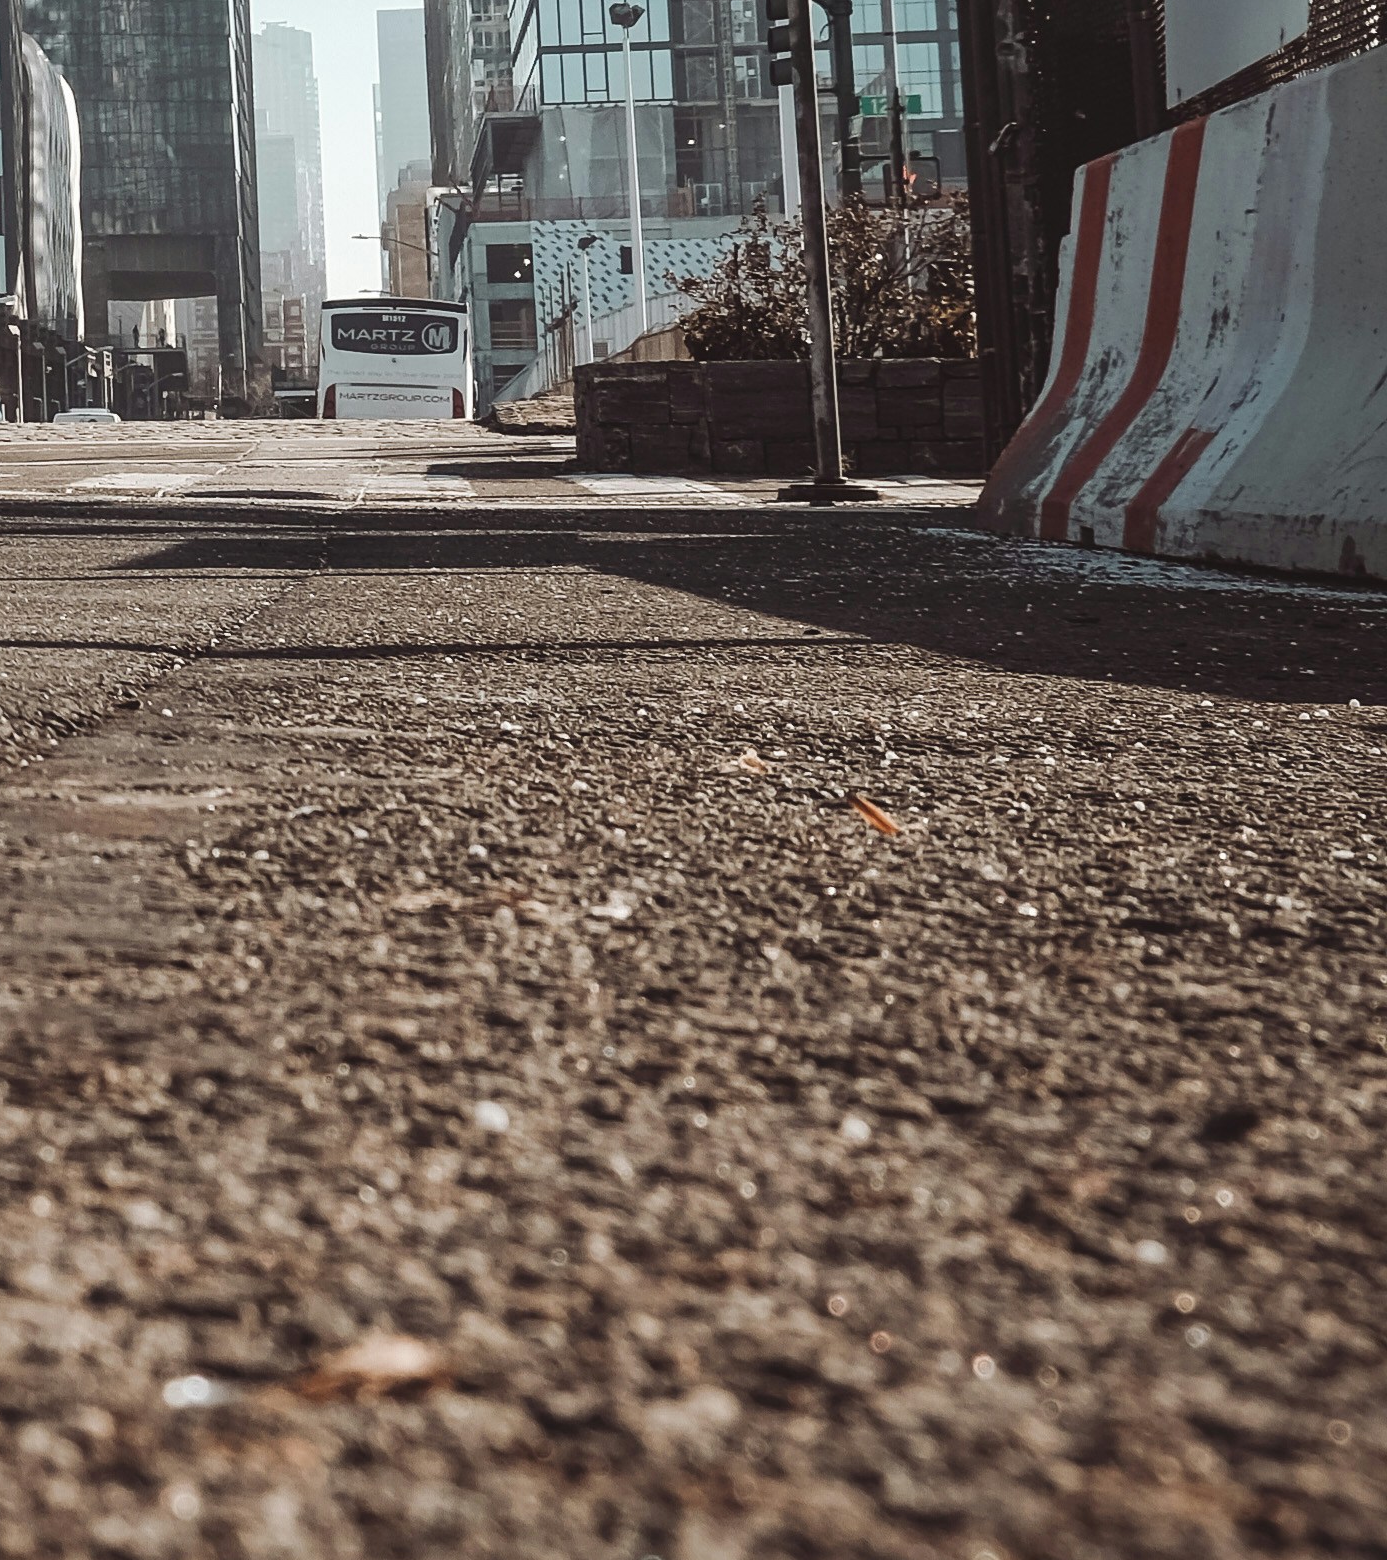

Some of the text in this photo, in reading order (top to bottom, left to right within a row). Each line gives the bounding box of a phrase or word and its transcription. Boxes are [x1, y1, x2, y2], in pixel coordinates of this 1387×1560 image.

[337, 328, 416, 342] MARTZ
[370, 343, 416, 351] GROUP
[339, 392, 450, 403] MARTZGROUP.COM
